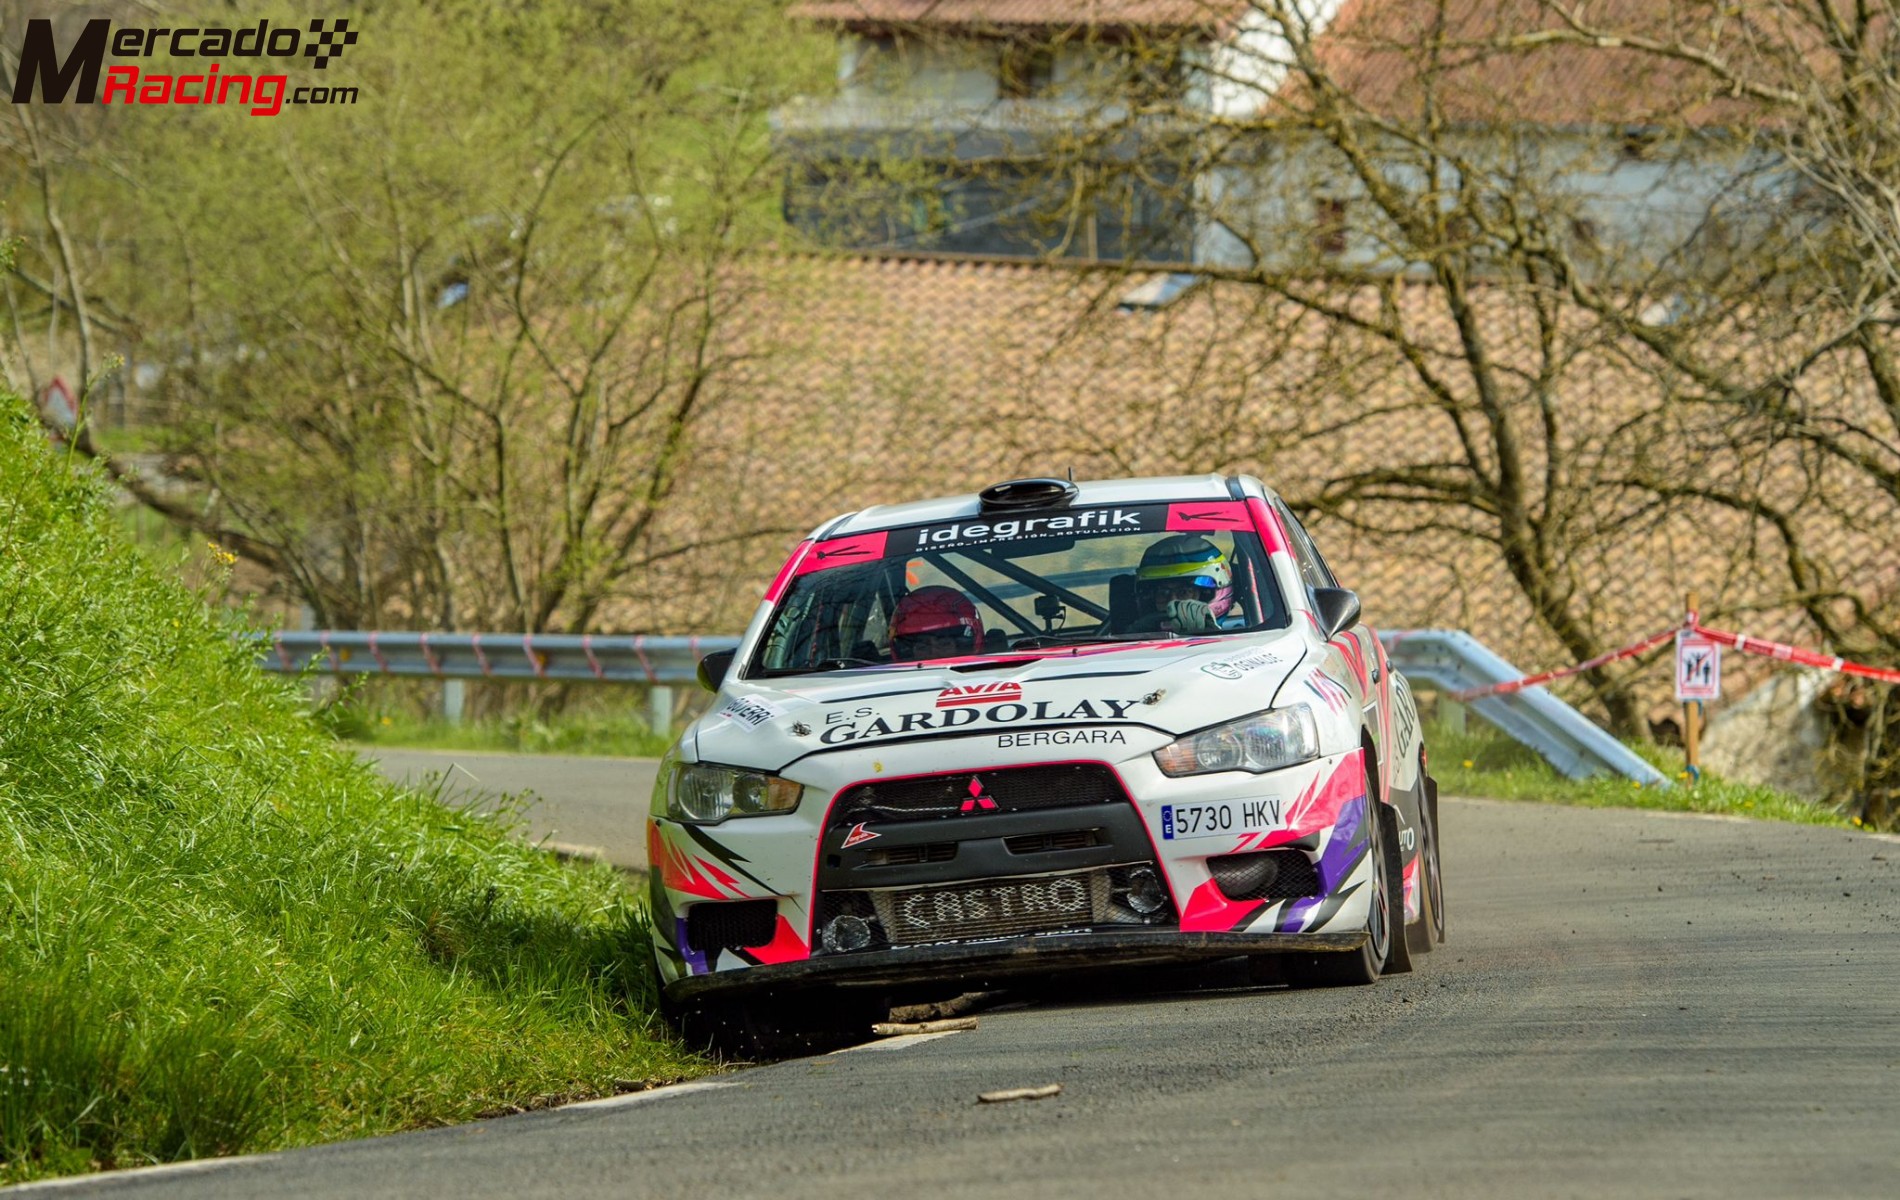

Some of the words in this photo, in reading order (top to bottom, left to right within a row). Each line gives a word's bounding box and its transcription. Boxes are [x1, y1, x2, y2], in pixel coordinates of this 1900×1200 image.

[918, 509, 1141, 545] idegrafik
[938, 681, 1022, 697] AVIA
[820, 699, 1140, 744] GARDOLAY
[825, 707, 881, 725] E.S.
[998, 730, 1127, 748] BERGARA
[1165, 824, 1172, 834] E
[1176, 805, 1232, 833] 5730
[1243, 799, 1280, 828] HKV
[904, 878, 1085, 930] CASTRO
